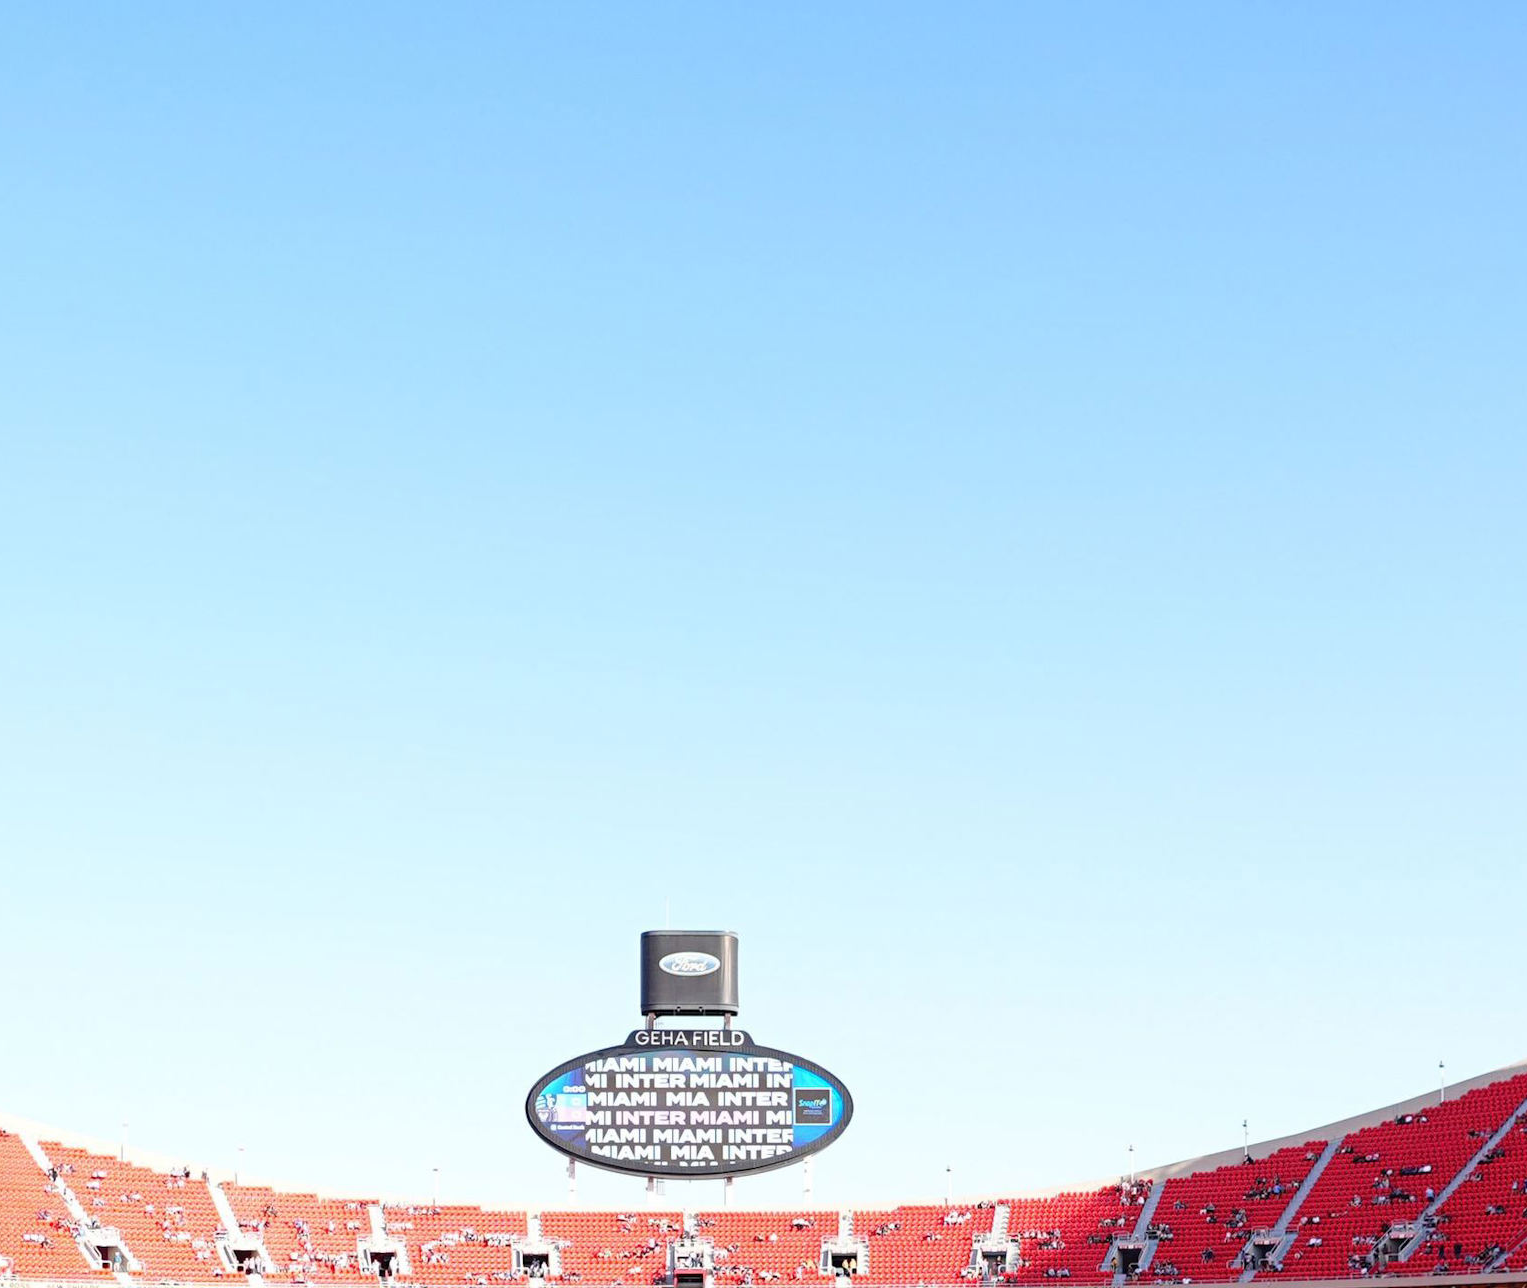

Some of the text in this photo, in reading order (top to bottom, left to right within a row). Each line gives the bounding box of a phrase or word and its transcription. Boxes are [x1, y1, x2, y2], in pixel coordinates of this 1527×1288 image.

[671, 957, 707, 971] Ford
[635, 1031, 745, 1046] GEHA FIELD
[653, 1057, 722, 1072] MIAMI
[616, 1074, 686, 1088] INTER
[690, 1074, 759, 1088] MIAMI
[588, 1092, 788, 1106] MIAMI MIA INTER
[586, 1111, 792, 1125] MI INTER MIAMI MI
[653, 1129, 722, 1143] MIAMI
[591, 1145, 661, 1160] MIAMI
[671, 1145, 714, 1160] MIA
